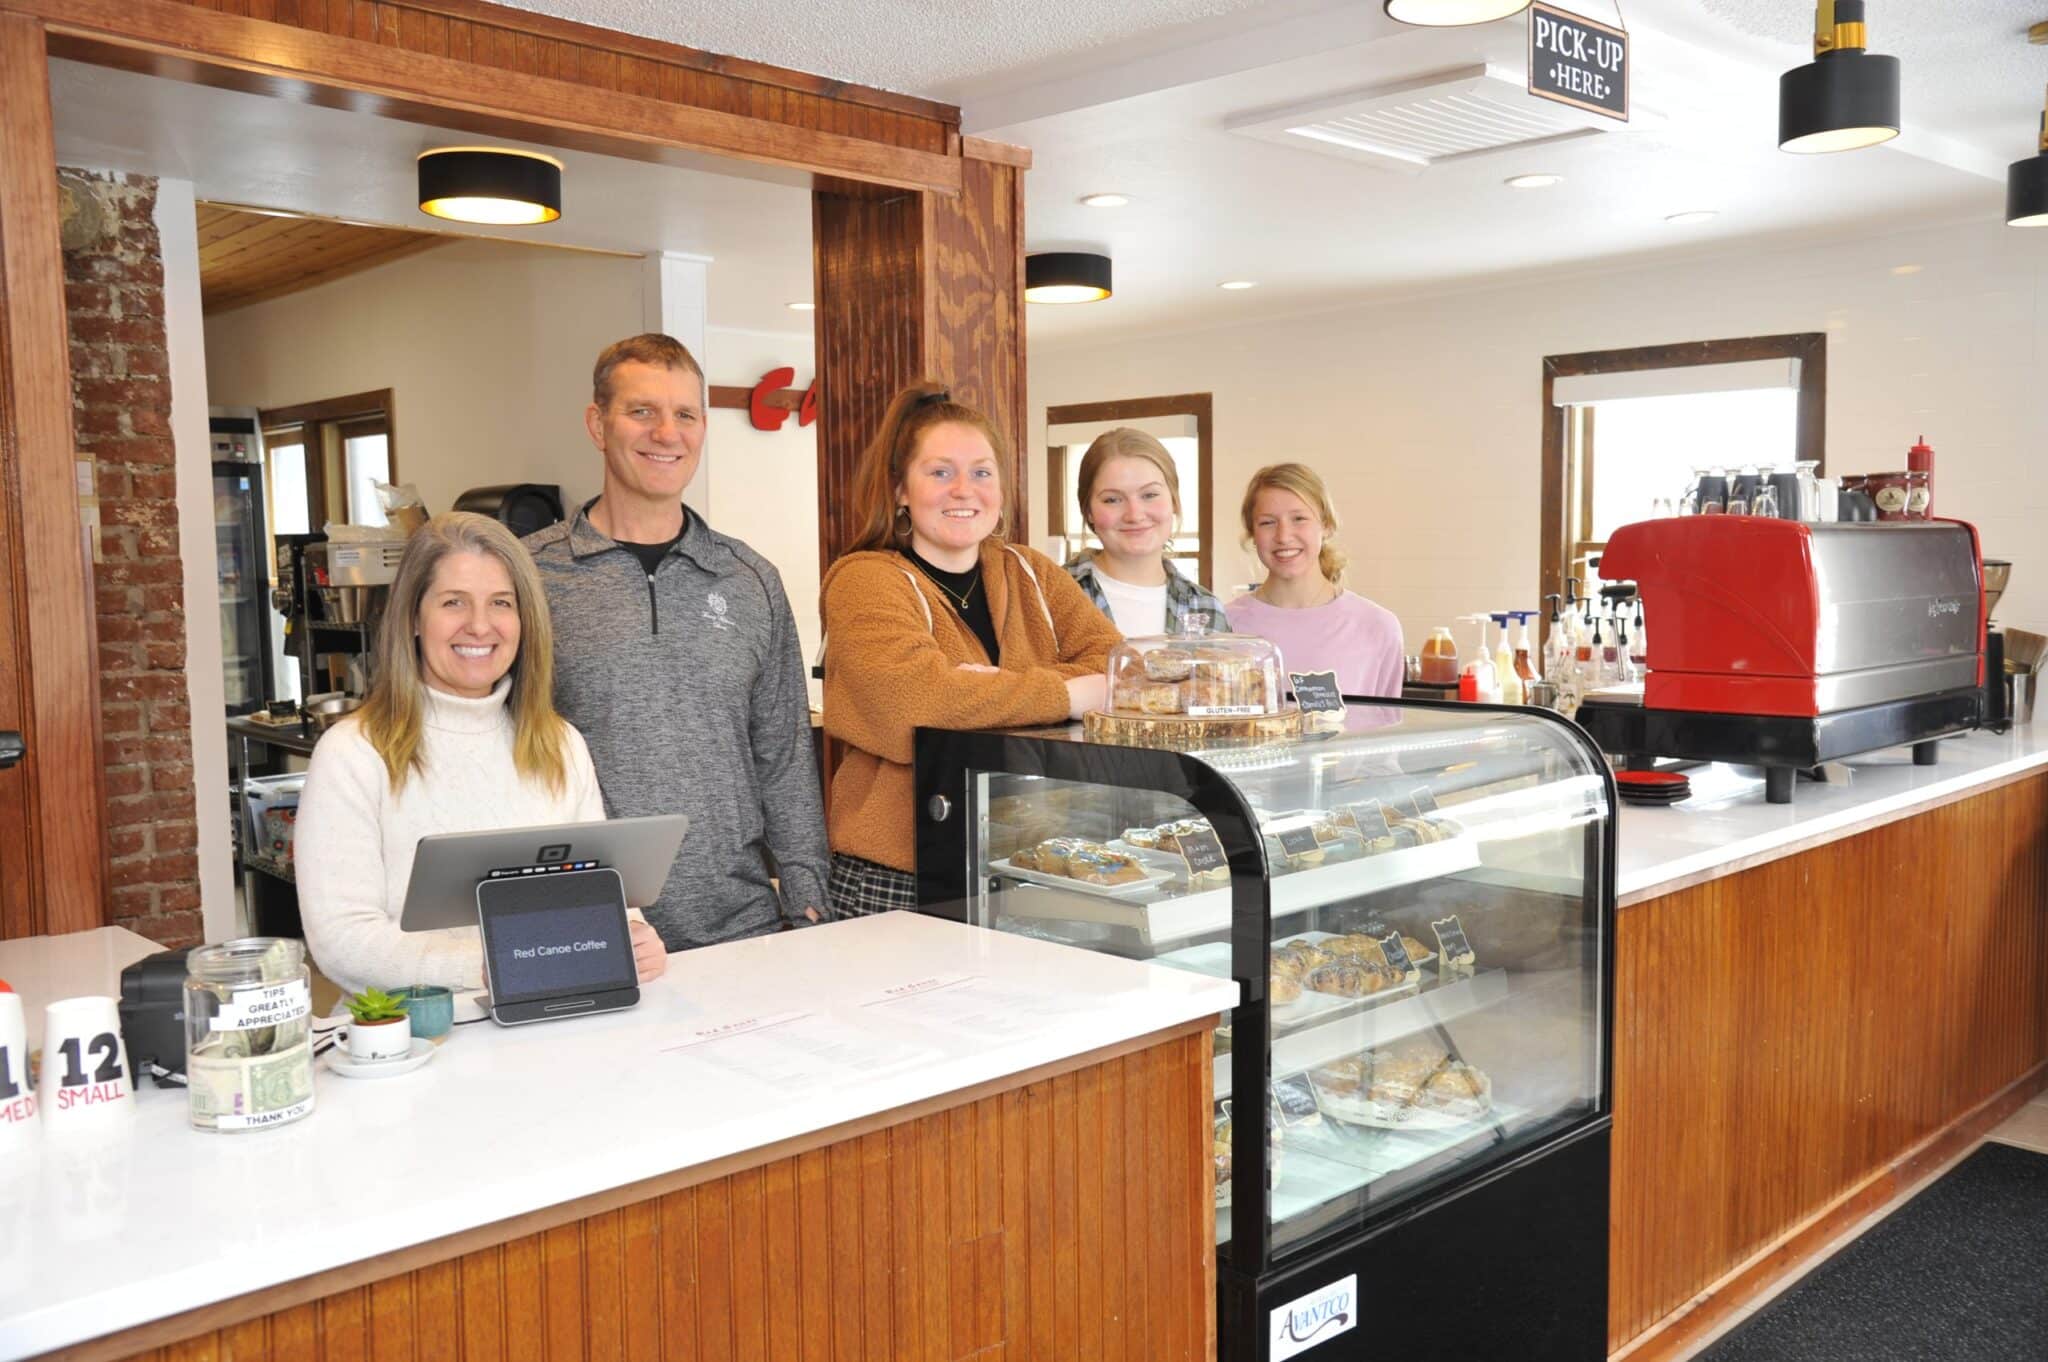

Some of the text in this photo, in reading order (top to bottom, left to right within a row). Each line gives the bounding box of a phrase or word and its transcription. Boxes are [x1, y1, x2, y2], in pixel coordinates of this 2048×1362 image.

[1536, 16, 1623, 72] PICK-UP
[1556, 62, 1605, 99] HERE
[1206, 706, 1251, 714] GLUTEN-FREE
[513, 940, 608, 960] Red Canoe Coffee
[263, 986, 286, 999] TIPS
[237, 1005, 306, 1027] APPRECIATED
[248, 998, 295, 1014] GREATLY
[58, 1032, 123, 1087] 12
[58, 1083, 125, 1110] SMALL
[246, 1105, 305, 1126] THANK YOU
